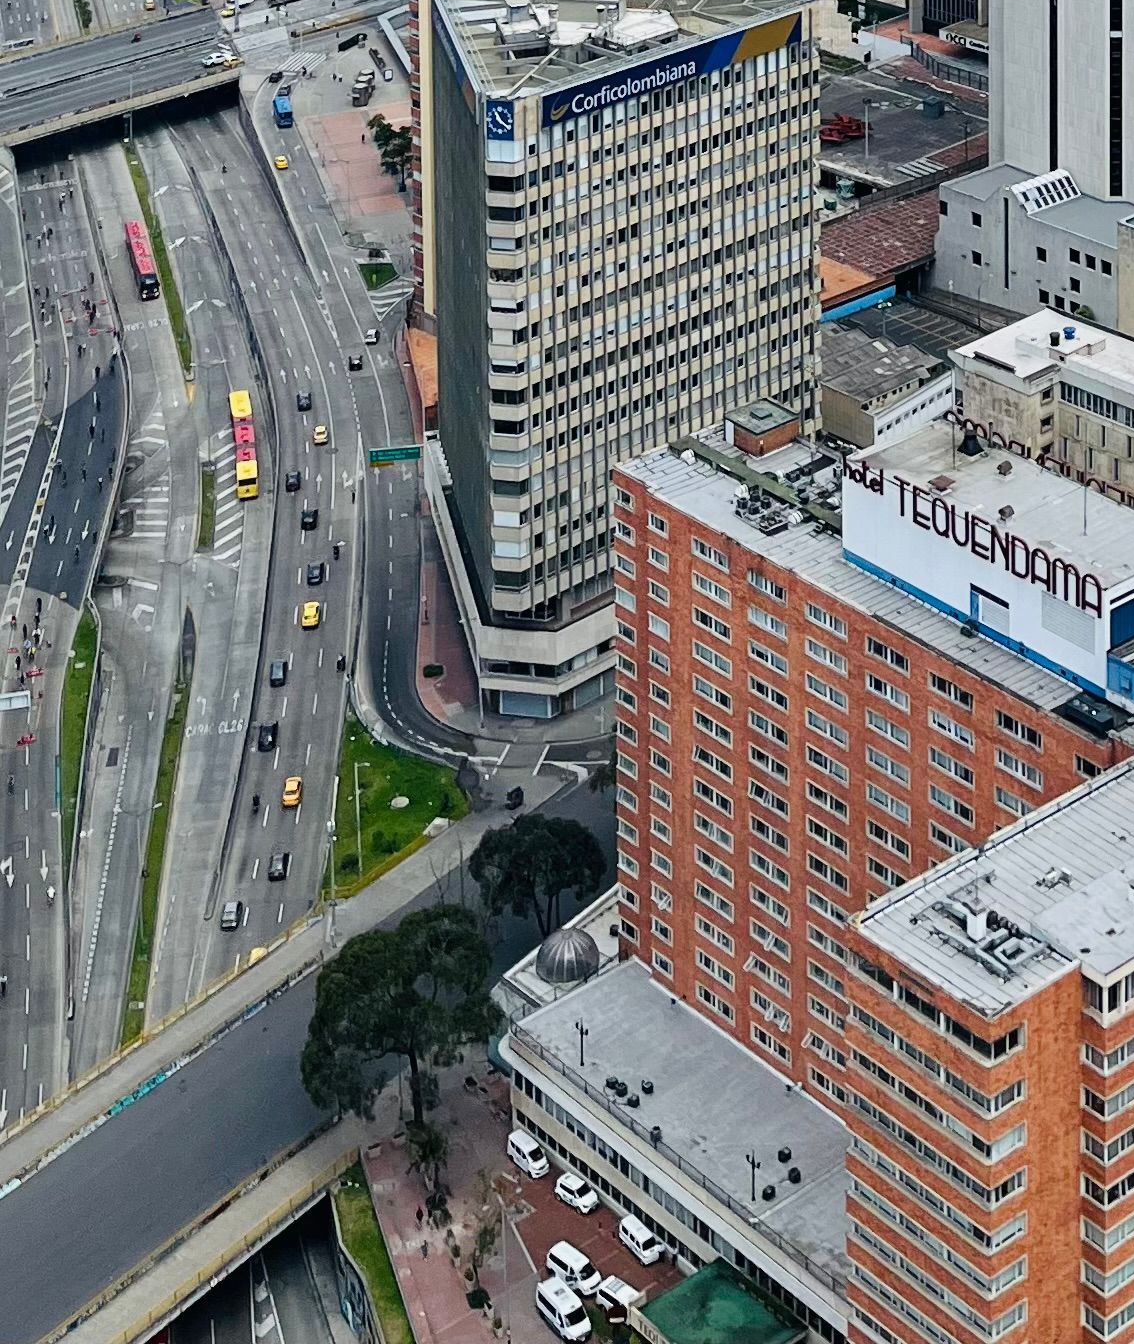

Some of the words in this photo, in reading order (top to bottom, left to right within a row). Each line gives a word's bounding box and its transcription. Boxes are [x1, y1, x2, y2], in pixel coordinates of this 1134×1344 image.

[571, 61, 696, 113] Corficolombiana
[843, 451, 884, 496] hotel
[894, 475, 1102, 619] TEQUENDAMA
